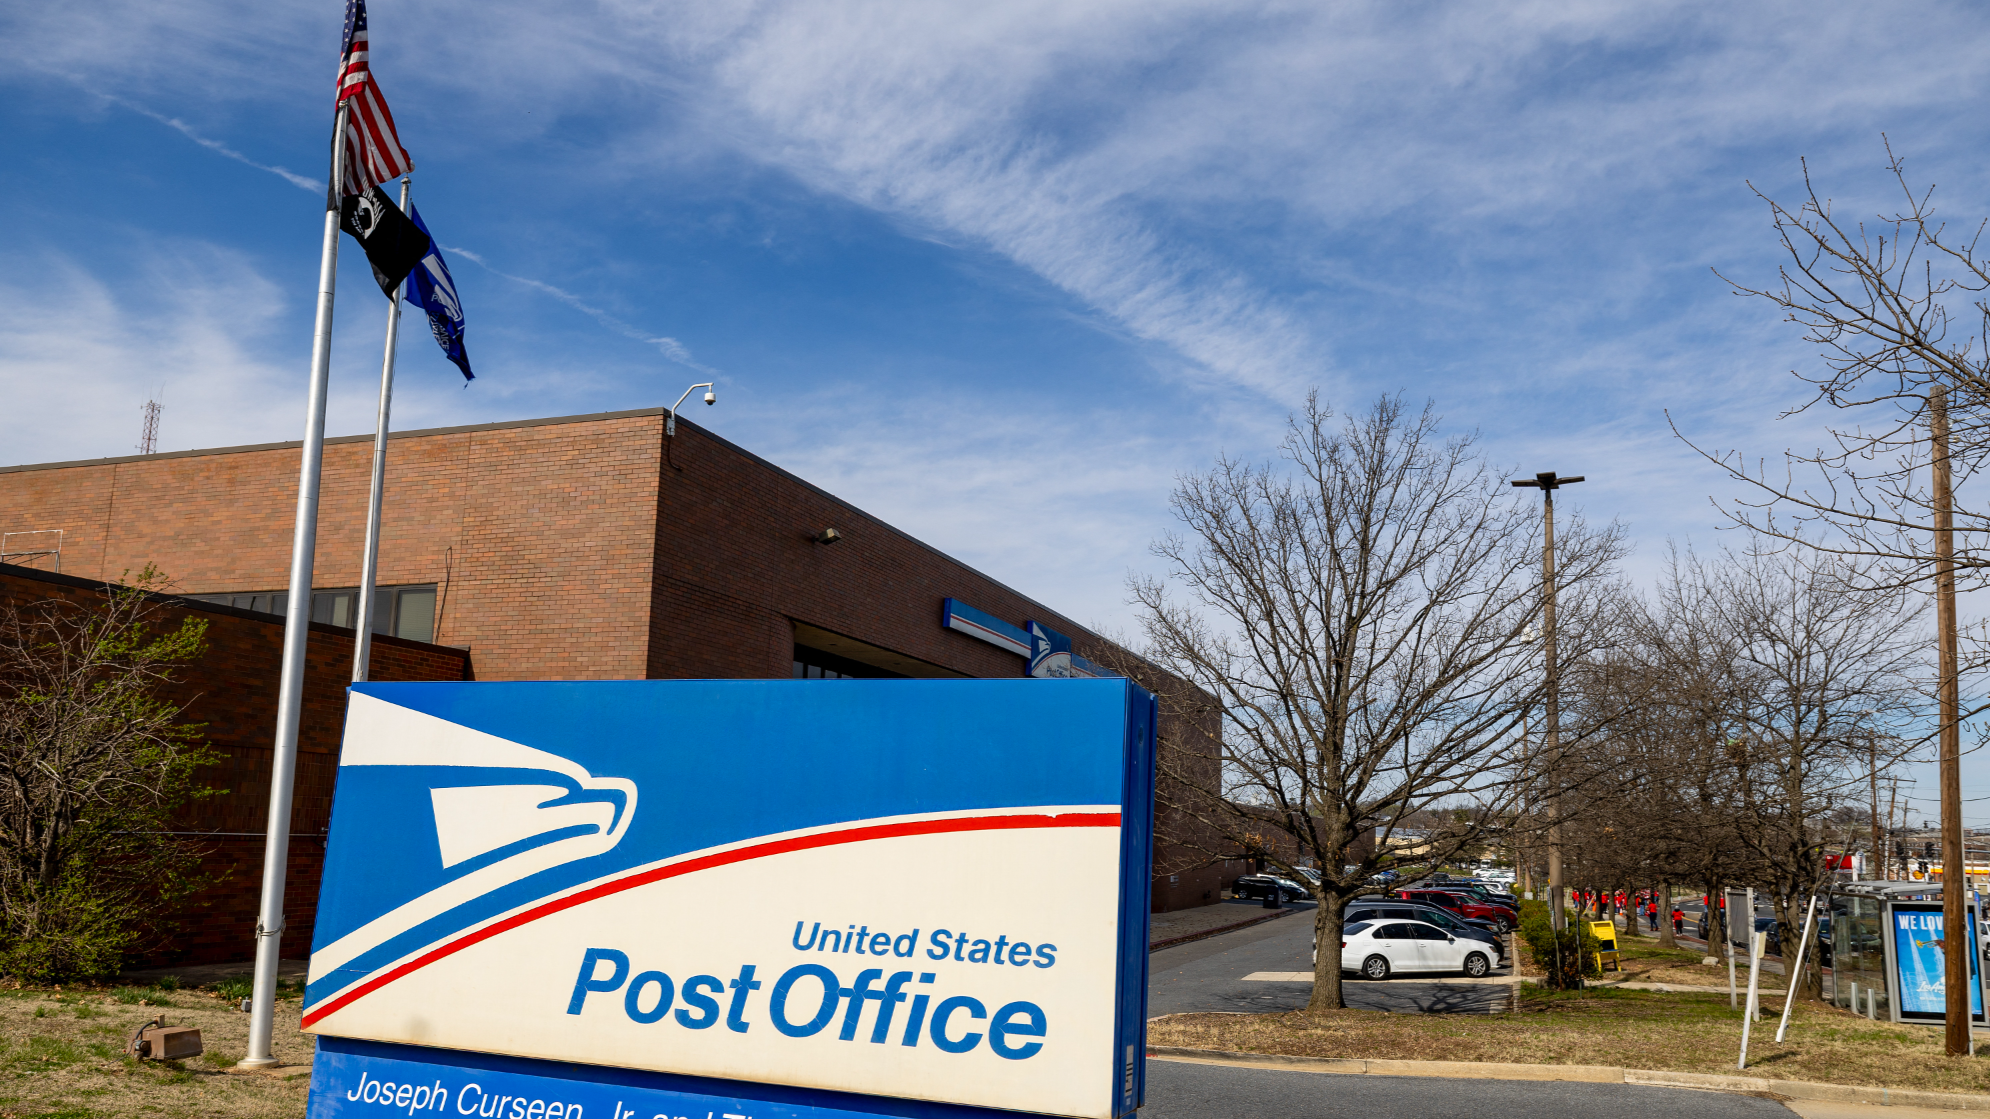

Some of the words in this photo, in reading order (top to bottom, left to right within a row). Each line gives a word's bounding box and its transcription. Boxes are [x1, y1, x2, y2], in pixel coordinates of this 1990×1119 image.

[793, 921, 921, 959] United
[926, 928, 1059, 970] States
[1898, 915, 1918, 930] WE
[1920, 916, 1944, 930] LOV
[566, 947, 762, 1035] Post
[769, 963, 1048, 1061] Office
[346, 1072, 448, 1116] Joseph
